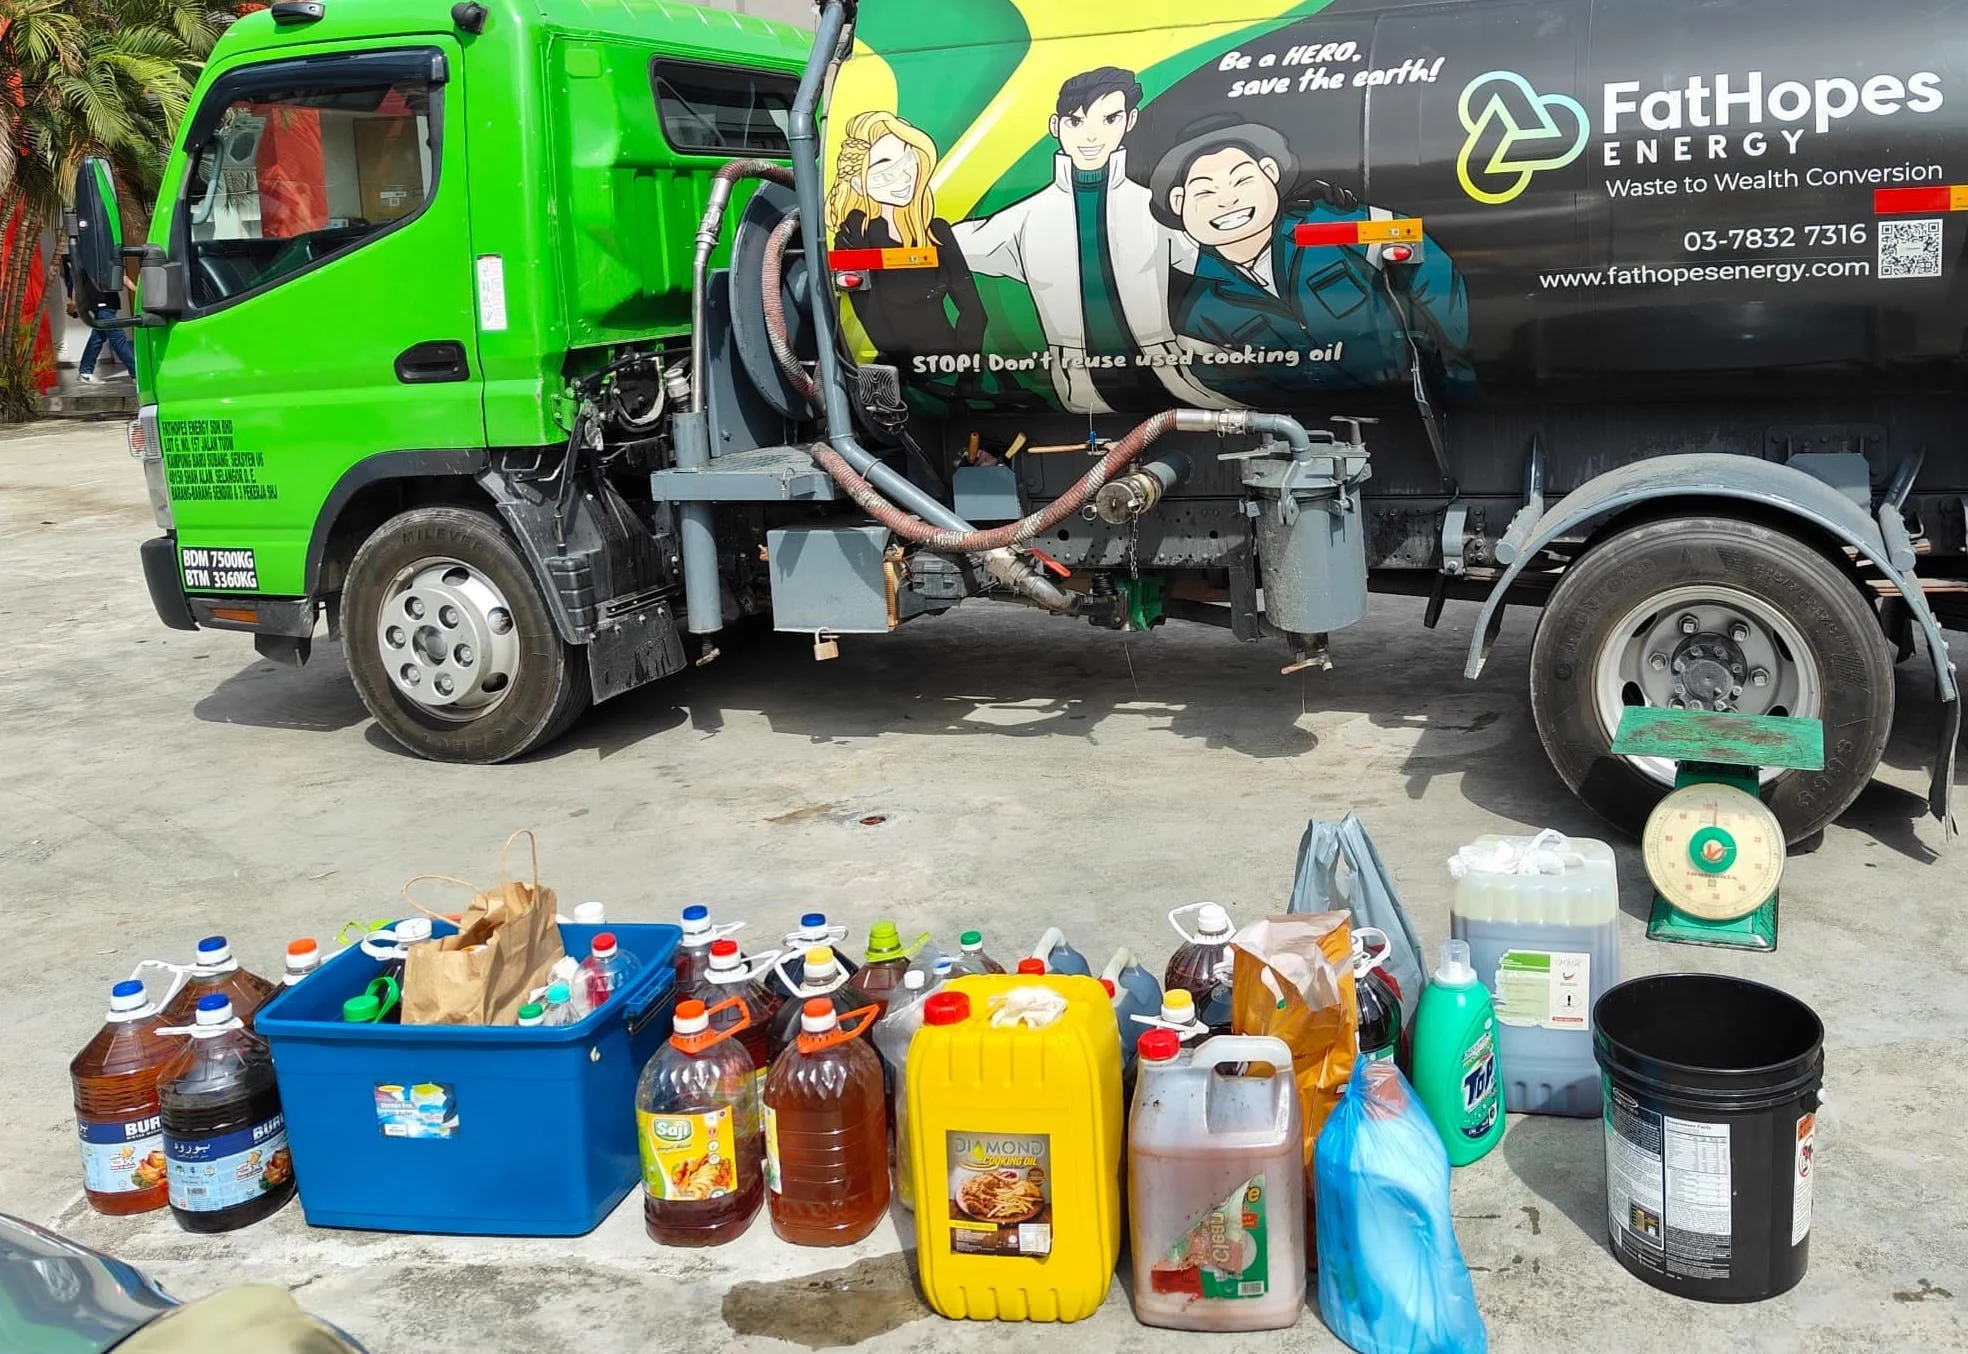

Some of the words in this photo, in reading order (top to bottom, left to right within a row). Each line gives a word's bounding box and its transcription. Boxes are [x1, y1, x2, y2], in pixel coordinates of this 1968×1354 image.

[1218, 51, 1252, 71] Be
[1258, 53, 1277, 67] a
[1281, 41, 1362, 66] HERO.
[1227, 77, 1291, 98] save
[1298, 67, 1346, 92] the
[1352, 57, 1446, 87] earth!
[1603, 71, 1944, 134] FatHopes
[1603, 129, 1805, 167] ENERGY
[1605, 177, 1678, 199] Waste
[1684, 174, 1707, 193] to
[1714, 168, 1799, 192] Wealth
[1806, 161, 1943, 187] Conversion
[1684, 227, 1796, 252] 03-7832
[1804, 223, 1867, 247] 7316
[1539, 258, 1870, 290] www.fathopesenergy.com
[913, 355, 980, 373] STOP!
[989, 351, 1051, 371] Don't
[1061, 354, 1127, 370] reuse
[1135, 348, 1193, 367] used
[1202, 343, 1300, 366] cooking
[1309, 341, 1343, 361] oil
[182, 549, 209, 567] BDM
[210, 551, 254, 568] 7500KG
[185, 569, 211, 587] BTM
[212, 571, 257, 588] 3360KG
[656, 1120, 688, 1140] Saji
[955, 1138, 1044, 1157] DIAMOND
[983, 1155, 1022, 1166] COOKING
[1023, 1156, 1037, 1166] OIL
